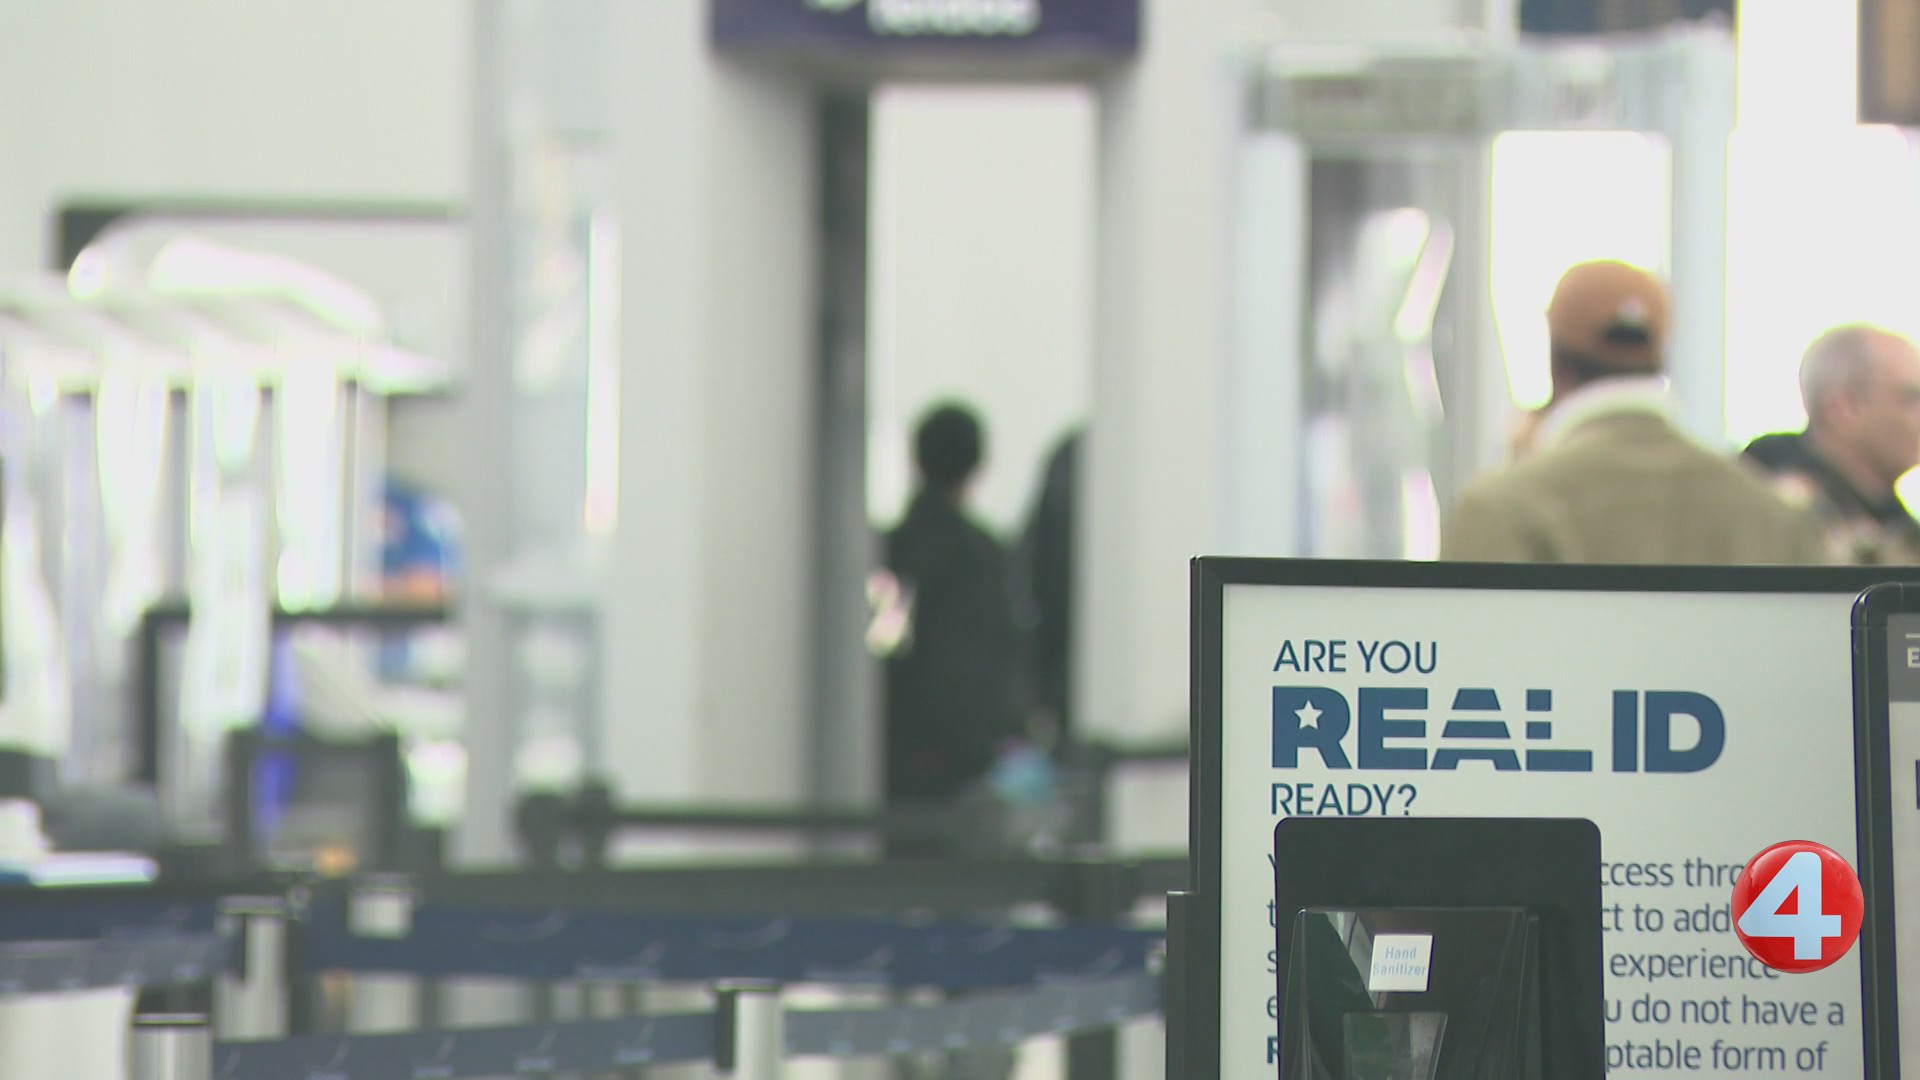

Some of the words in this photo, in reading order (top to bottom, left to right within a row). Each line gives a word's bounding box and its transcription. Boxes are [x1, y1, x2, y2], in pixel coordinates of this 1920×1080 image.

[1273, 640, 1347, 673] ARE
[1357, 641, 1438, 674] YOU
[1272, 686, 1593, 771] REAL
[1611, 690, 1726, 773] ID
[1271, 783, 1418, 816] READY?
[1633, 903, 1664, 932] to
[1385, 947, 1417, 960] Hand
[1373, 963, 1427, 977] Sanitizer
[1631, 993, 1671, 1024] do
[1681, 996, 1732, 1025] not
[1741, 994, 1818, 1026] have
[1827, 1001, 1845, 1027] a
[1711, 1040, 1786, 1071] form
[1796, 1041, 1829, 1072] of
